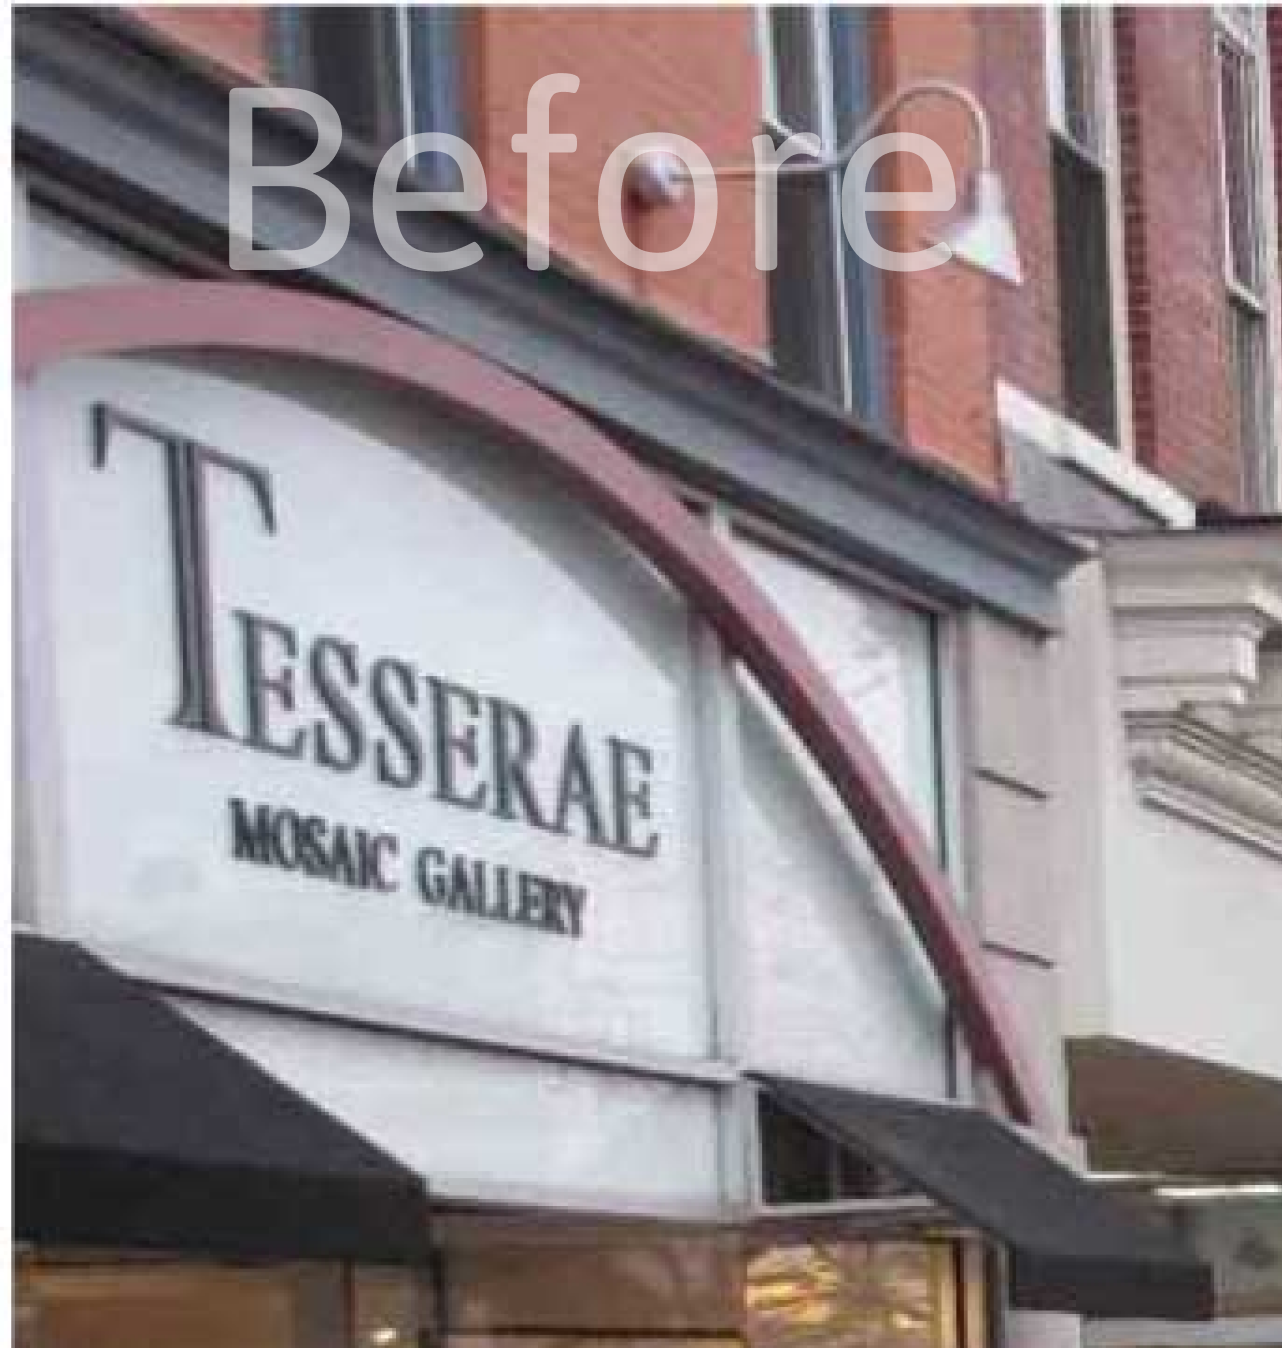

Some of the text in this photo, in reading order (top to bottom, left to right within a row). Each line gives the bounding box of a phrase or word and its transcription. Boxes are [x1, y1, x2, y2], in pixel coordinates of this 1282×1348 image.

[90, 402, 660, 857] TESSERAE
[227, 798, 587, 938] MOSAIC GALLERY
